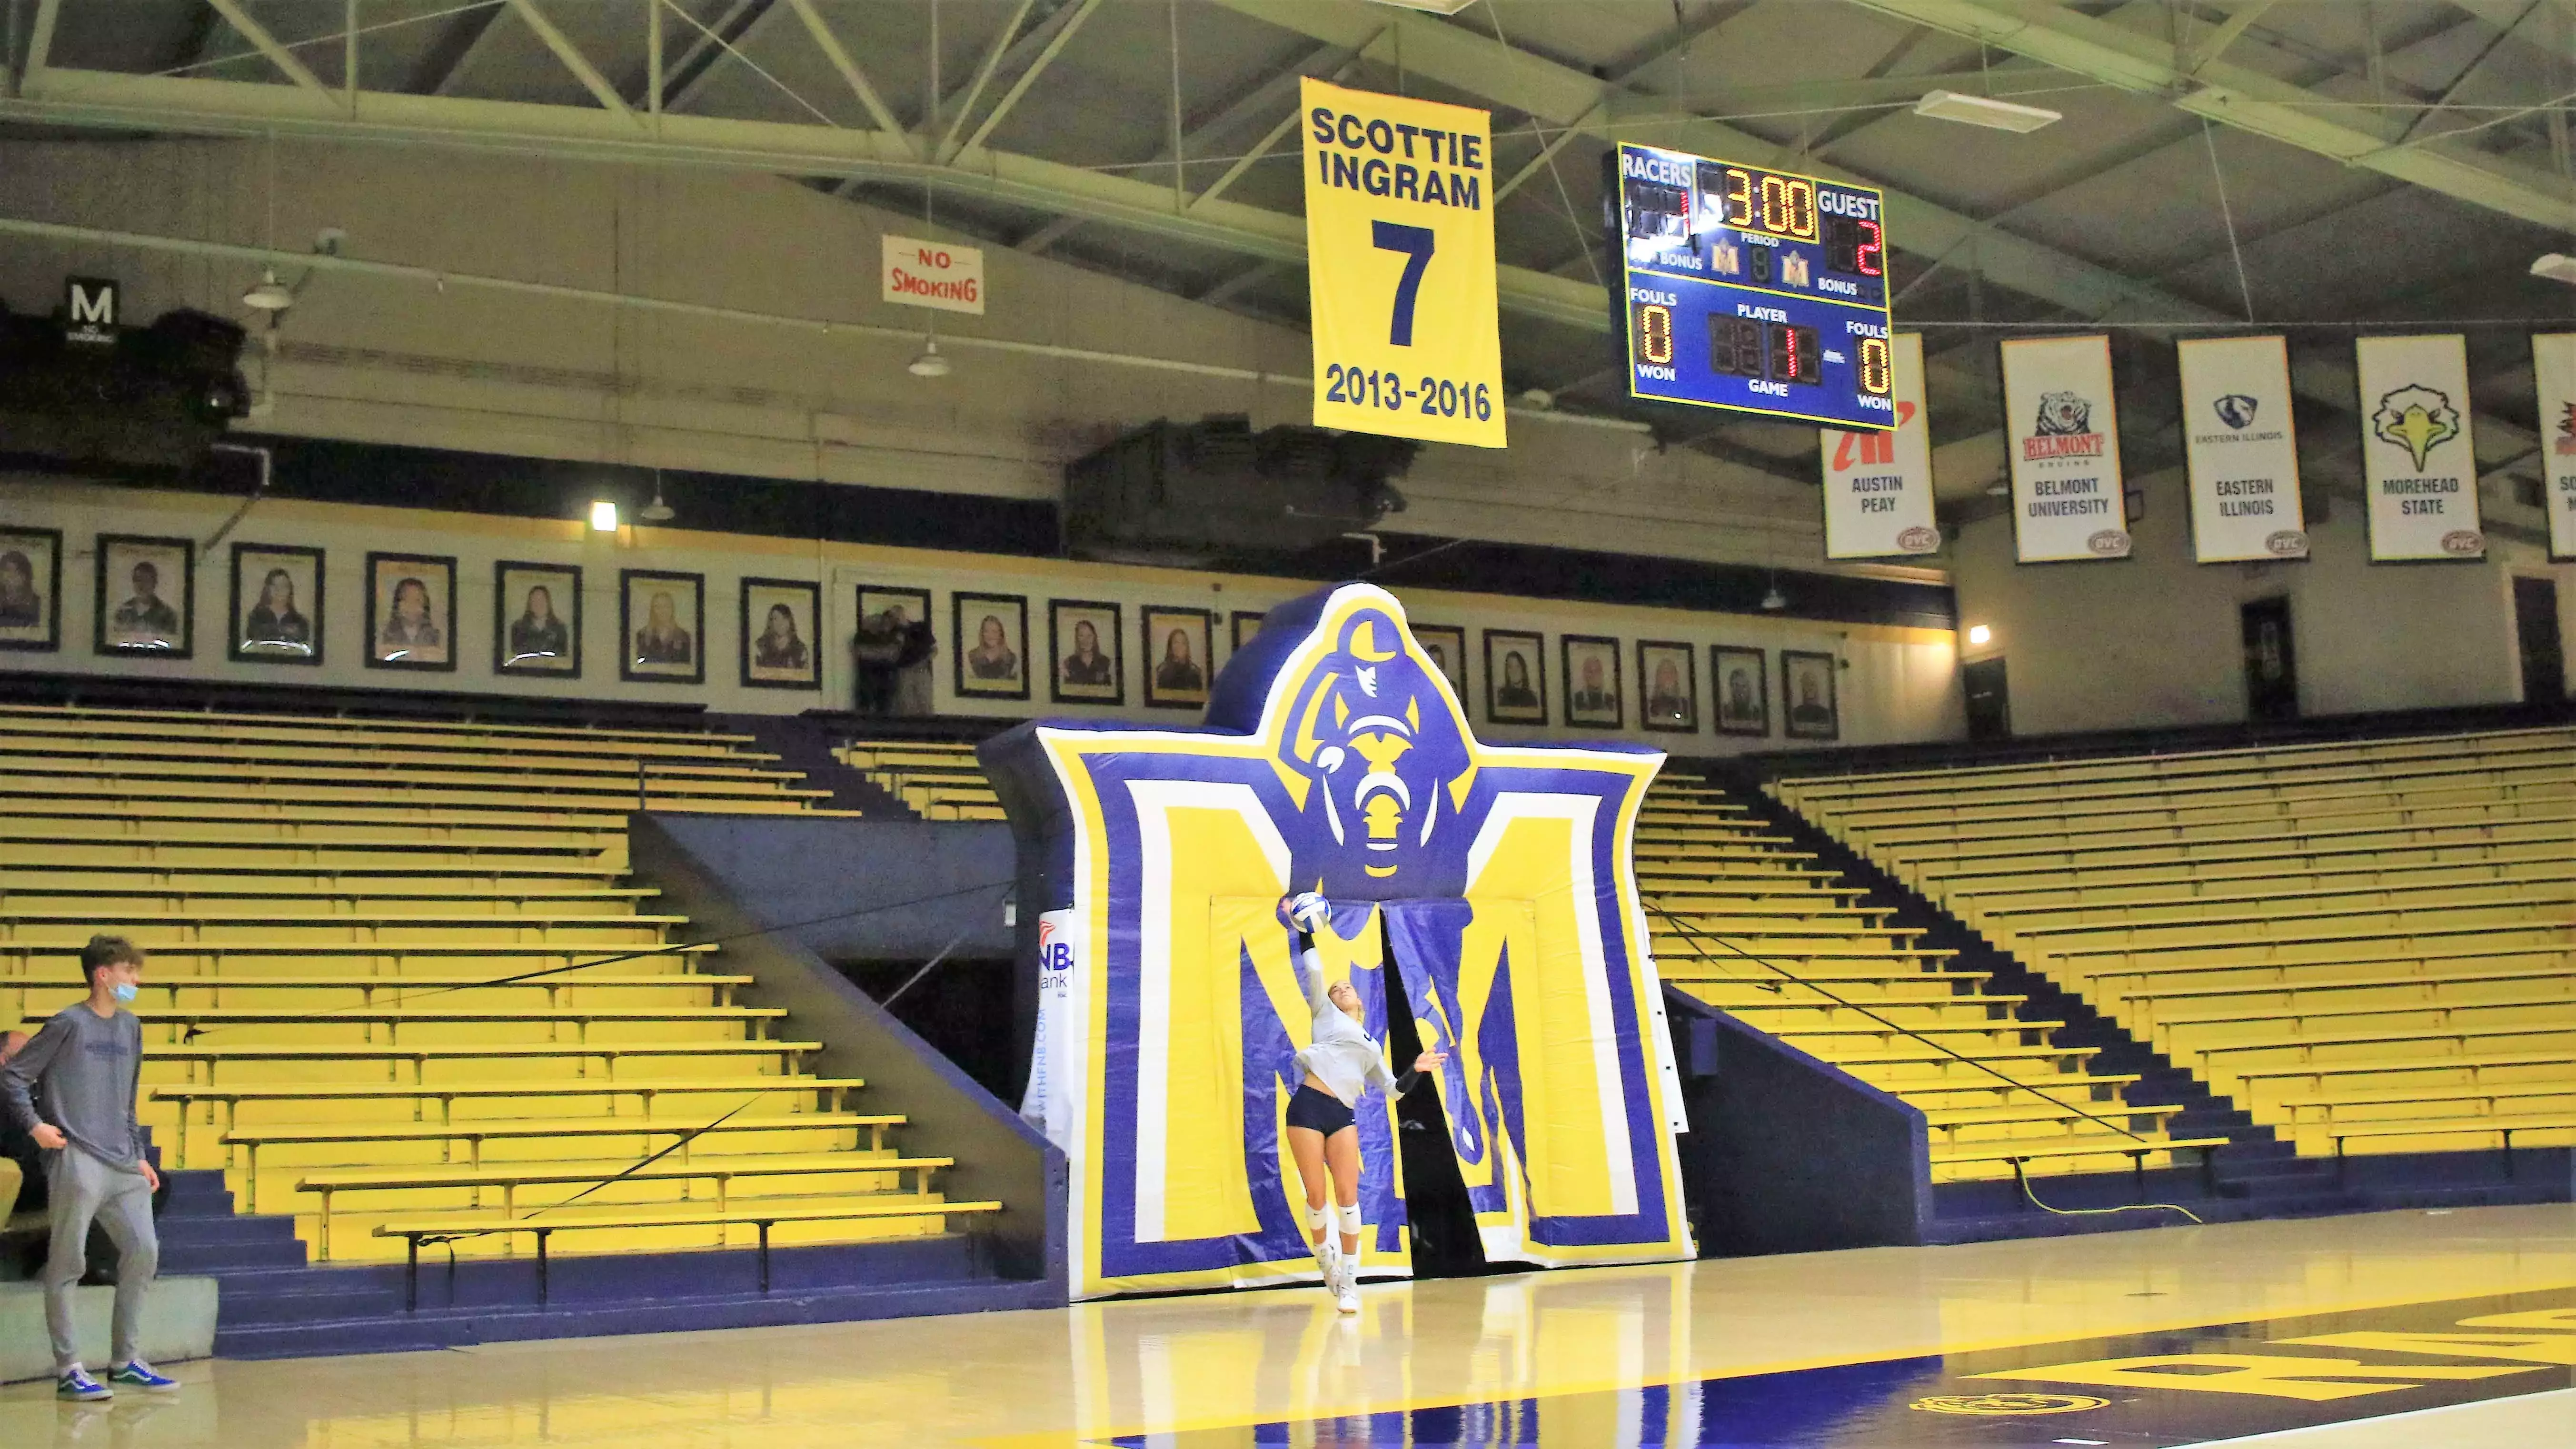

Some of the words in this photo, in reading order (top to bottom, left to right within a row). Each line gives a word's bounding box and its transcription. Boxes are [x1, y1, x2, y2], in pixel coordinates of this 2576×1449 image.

[1312, 108, 1483, 169] SCOTTIE
[1622, 153, 1691, 187] RACERS
[1320, 150, 1480, 210] INGRAM
[1726, 169, 1814, 237] 3:00
[1818, 190, 1879, 221] GUEST
[1741, 232, 1780, 248] PERIOD
[1858, 220, 1882, 276] 2
[918, 248, 951, 268] NO
[1660, 251, 1702, 270] BONUS
[892, 268, 976, 301] SMOKING
[1372, 220, 1435, 347] 7
[1818, 278, 1857, 296] BONUS
[72, 284, 112, 324] M
[1630, 288, 1677, 306] FOULS
[1737, 304, 1787, 323] PLAYER
[1642, 305, 1672, 364] 0
[1846, 320, 1889, 339] FOULS
[1786, 328, 1797, 377] 1
[1637, 364, 1676, 381] WON
[1862, 337, 1889, 394] 0
[1327, 364, 1491, 421] 2013-2016
[1748, 378, 1789, 397] GAME
[1858, 395, 1892, 411] WON
[2024, 433, 2105, 460] BELMONT
[2195, 434, 2239, 444] EASTERN
[2242, 431, 2283, 442] ILLINOIS
[1852, 476, 1903, 492] AUSTIN
[2035, 478, 2099, 496] BELMONT
[2216, 479, 2273, 495] EASTERN
[2383, 478, 2459, 495] MOREHEAD
[1862, 497, 1896, 513] PEAY
[2029, 498, 2109, 517] UNIVERSITY
[2220, 500, 2274, 516] ILLINOIS
[2402, 499, 2444, 515] STATE
[2095, 537, 2120, 548] OVC
[2273, 537, 2298, 548] OVC
